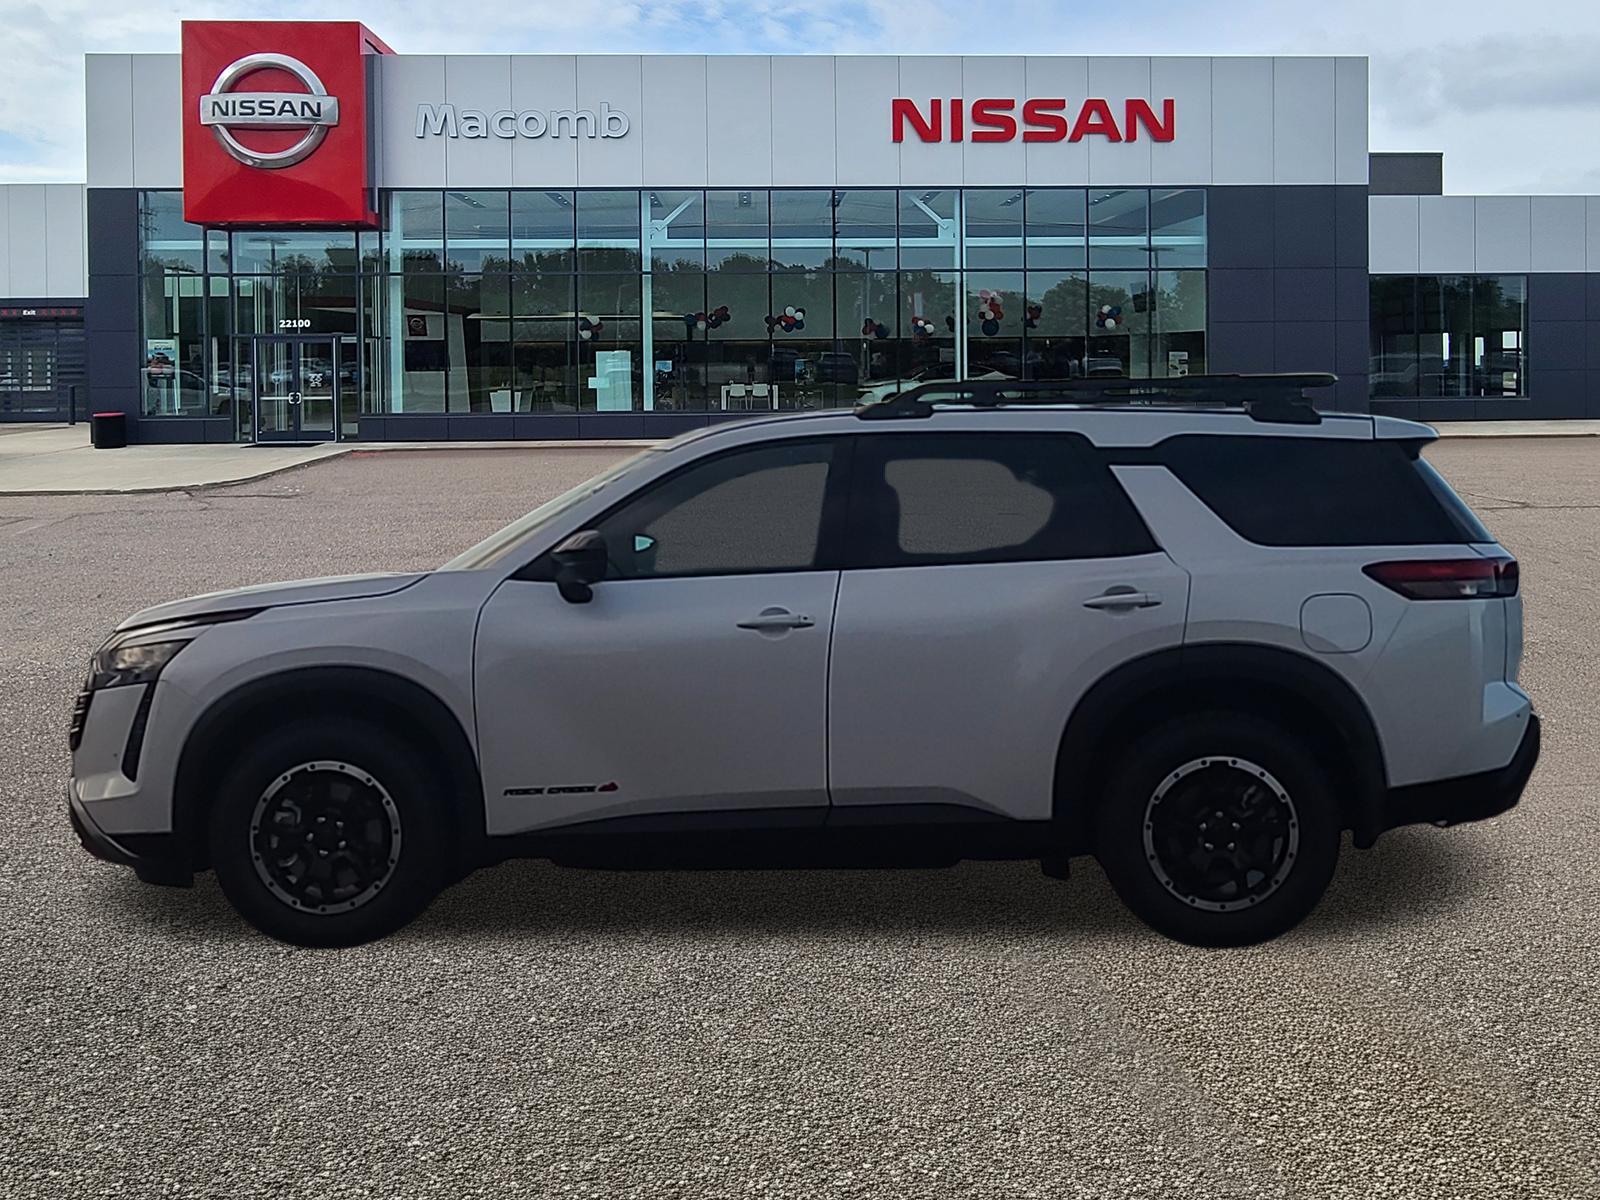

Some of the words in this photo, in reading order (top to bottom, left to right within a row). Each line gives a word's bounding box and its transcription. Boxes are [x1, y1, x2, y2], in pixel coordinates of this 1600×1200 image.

[211, 99, 323, 119] NISSAN
[415, 102, 630, 140] Macomb
[891, 98, 1176, 143] NISSAN
[279, 319, 311, 328] 22100
